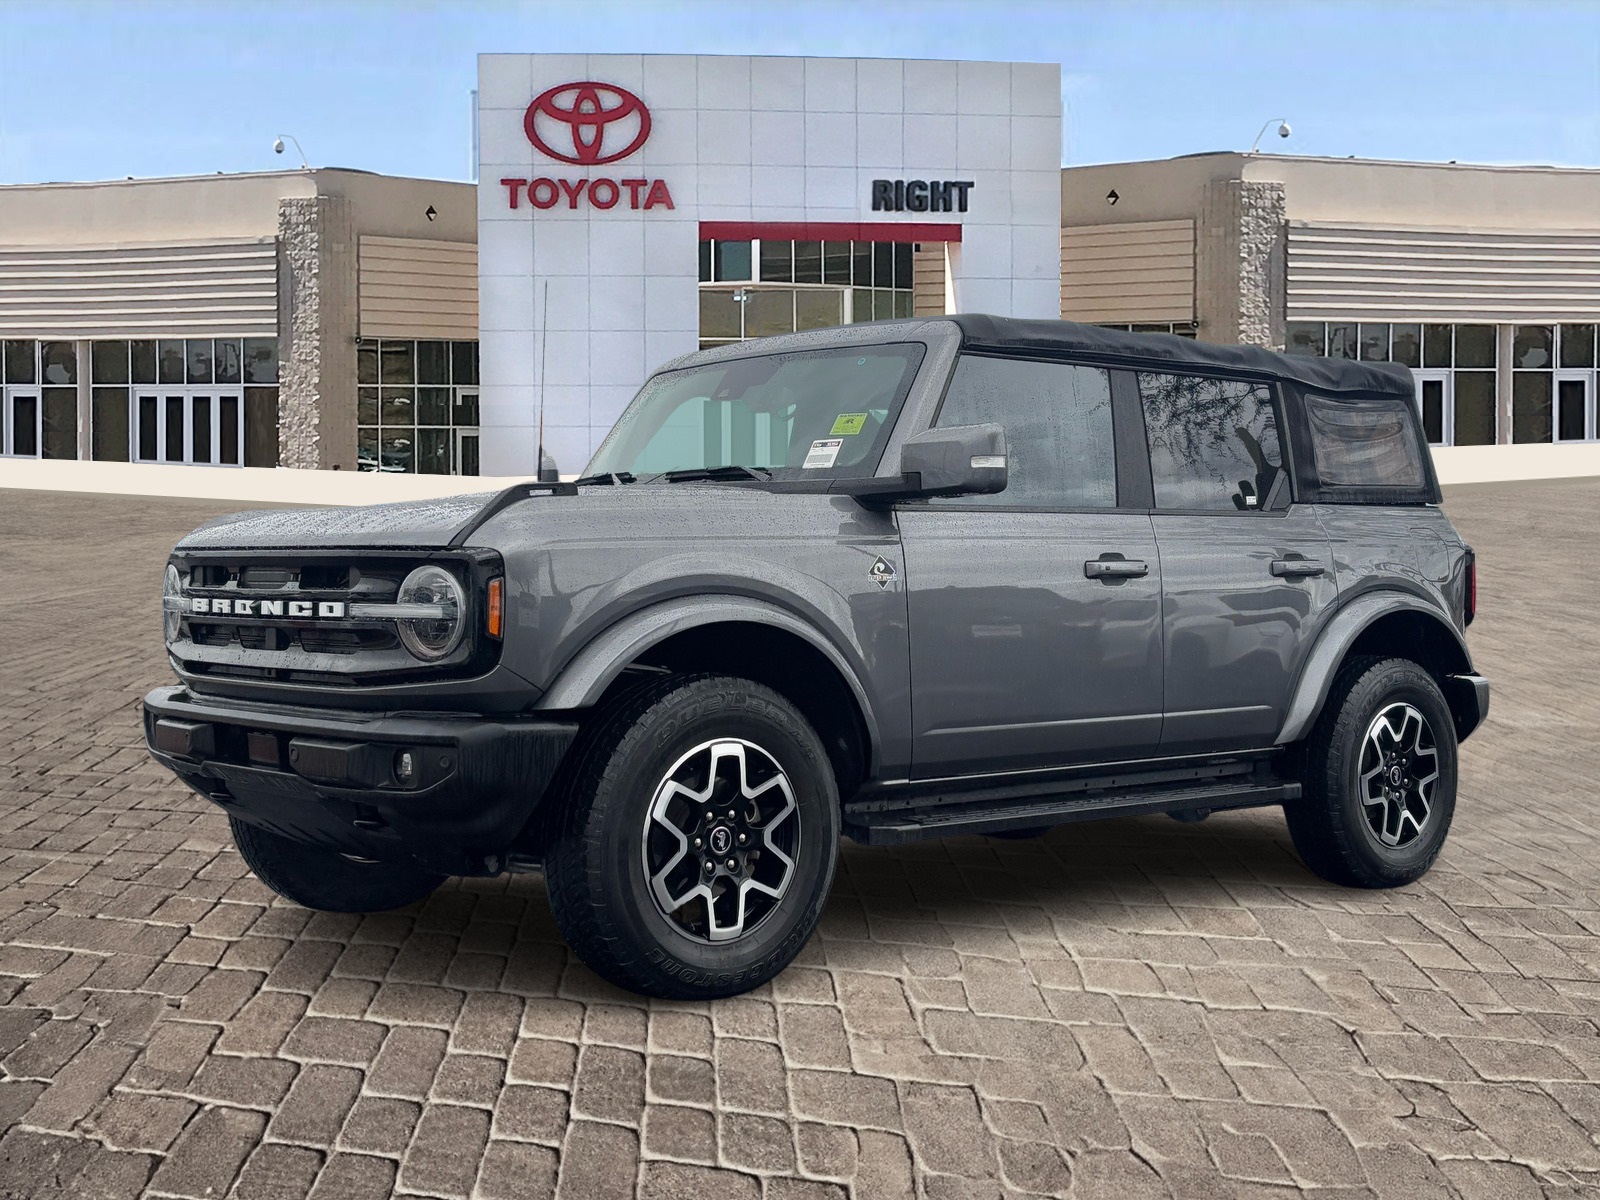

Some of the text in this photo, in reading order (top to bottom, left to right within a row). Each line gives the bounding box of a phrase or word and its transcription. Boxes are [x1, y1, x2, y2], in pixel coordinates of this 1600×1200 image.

[500, 177, 676, 210] TOYOTA
[872, 179, 975, 213] RIGHT
[191, 598, 345, 618] BRONCO
